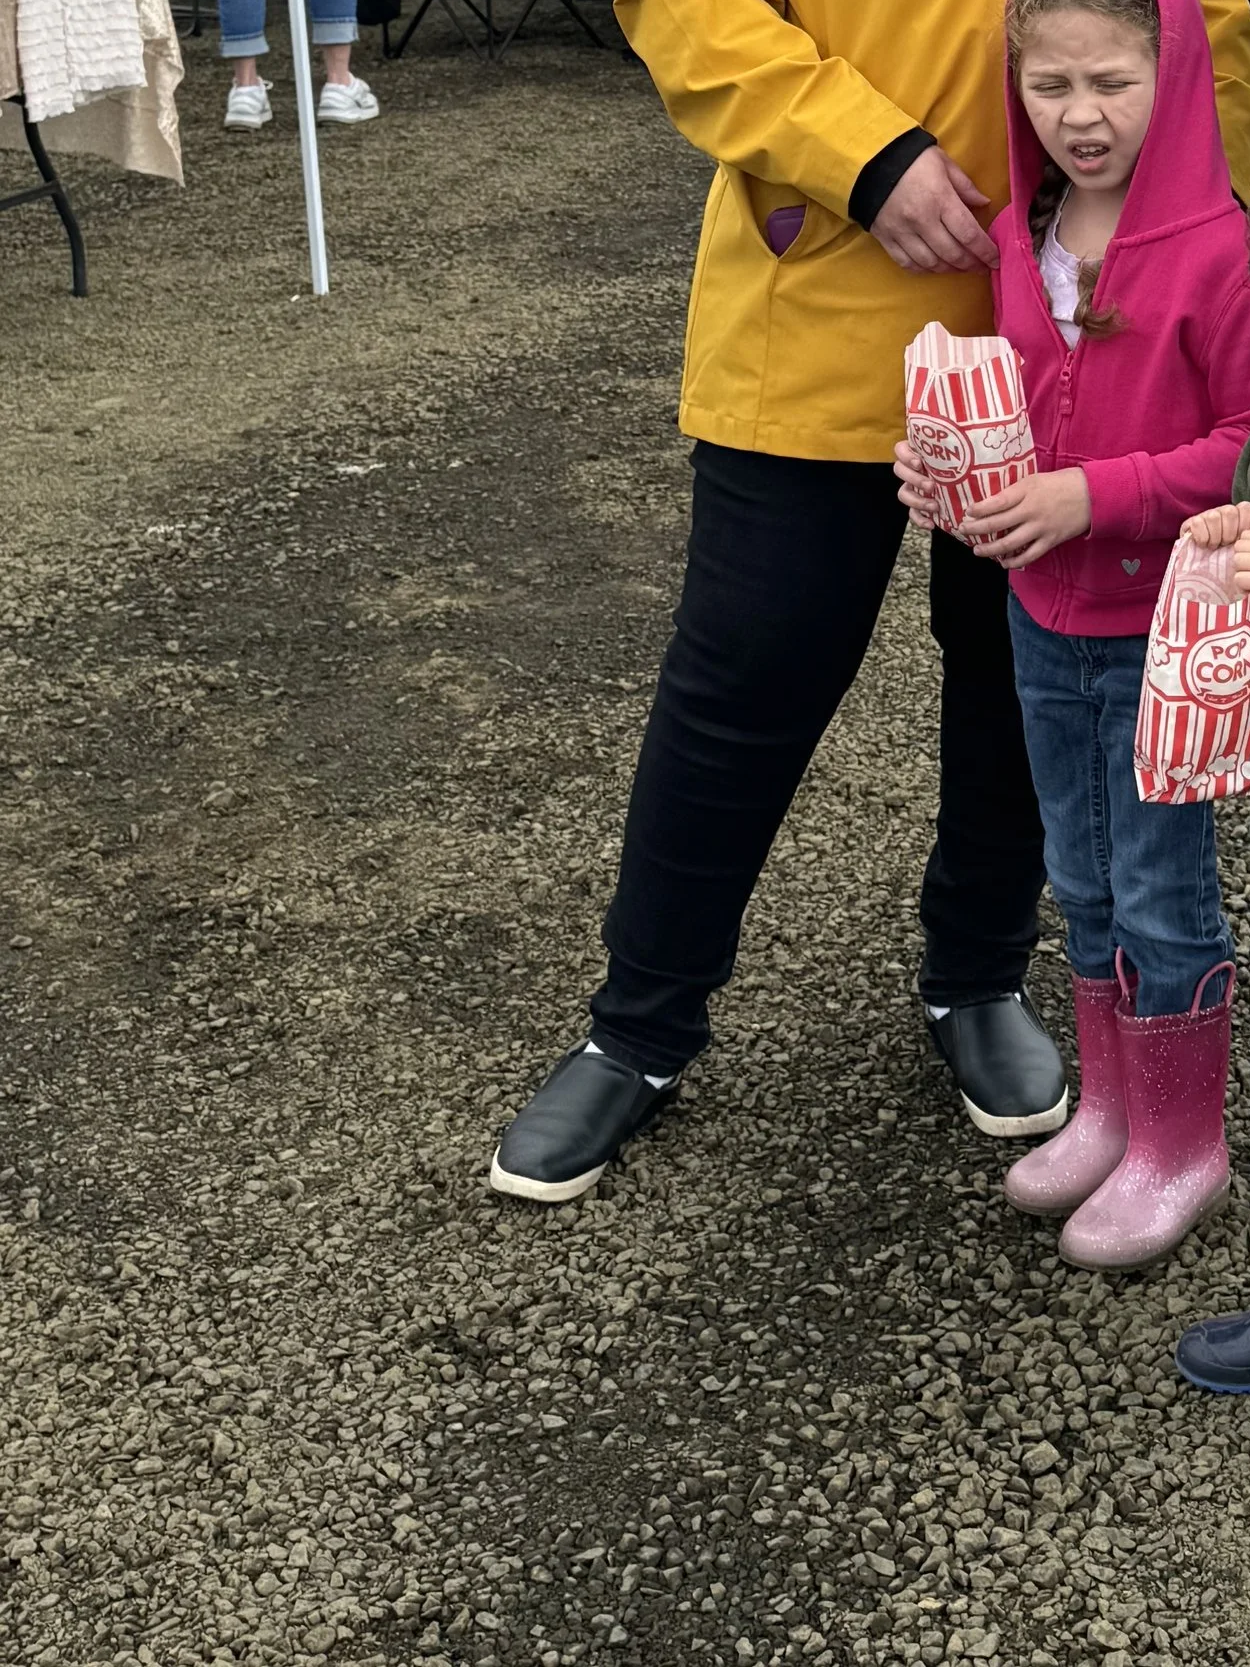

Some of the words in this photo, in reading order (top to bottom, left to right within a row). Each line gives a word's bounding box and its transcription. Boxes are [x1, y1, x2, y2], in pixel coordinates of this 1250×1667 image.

[913, 423, 948, 441] POP
[913, 437, 961, 462] CORN
[1211, 638, 1247, 660] POP
